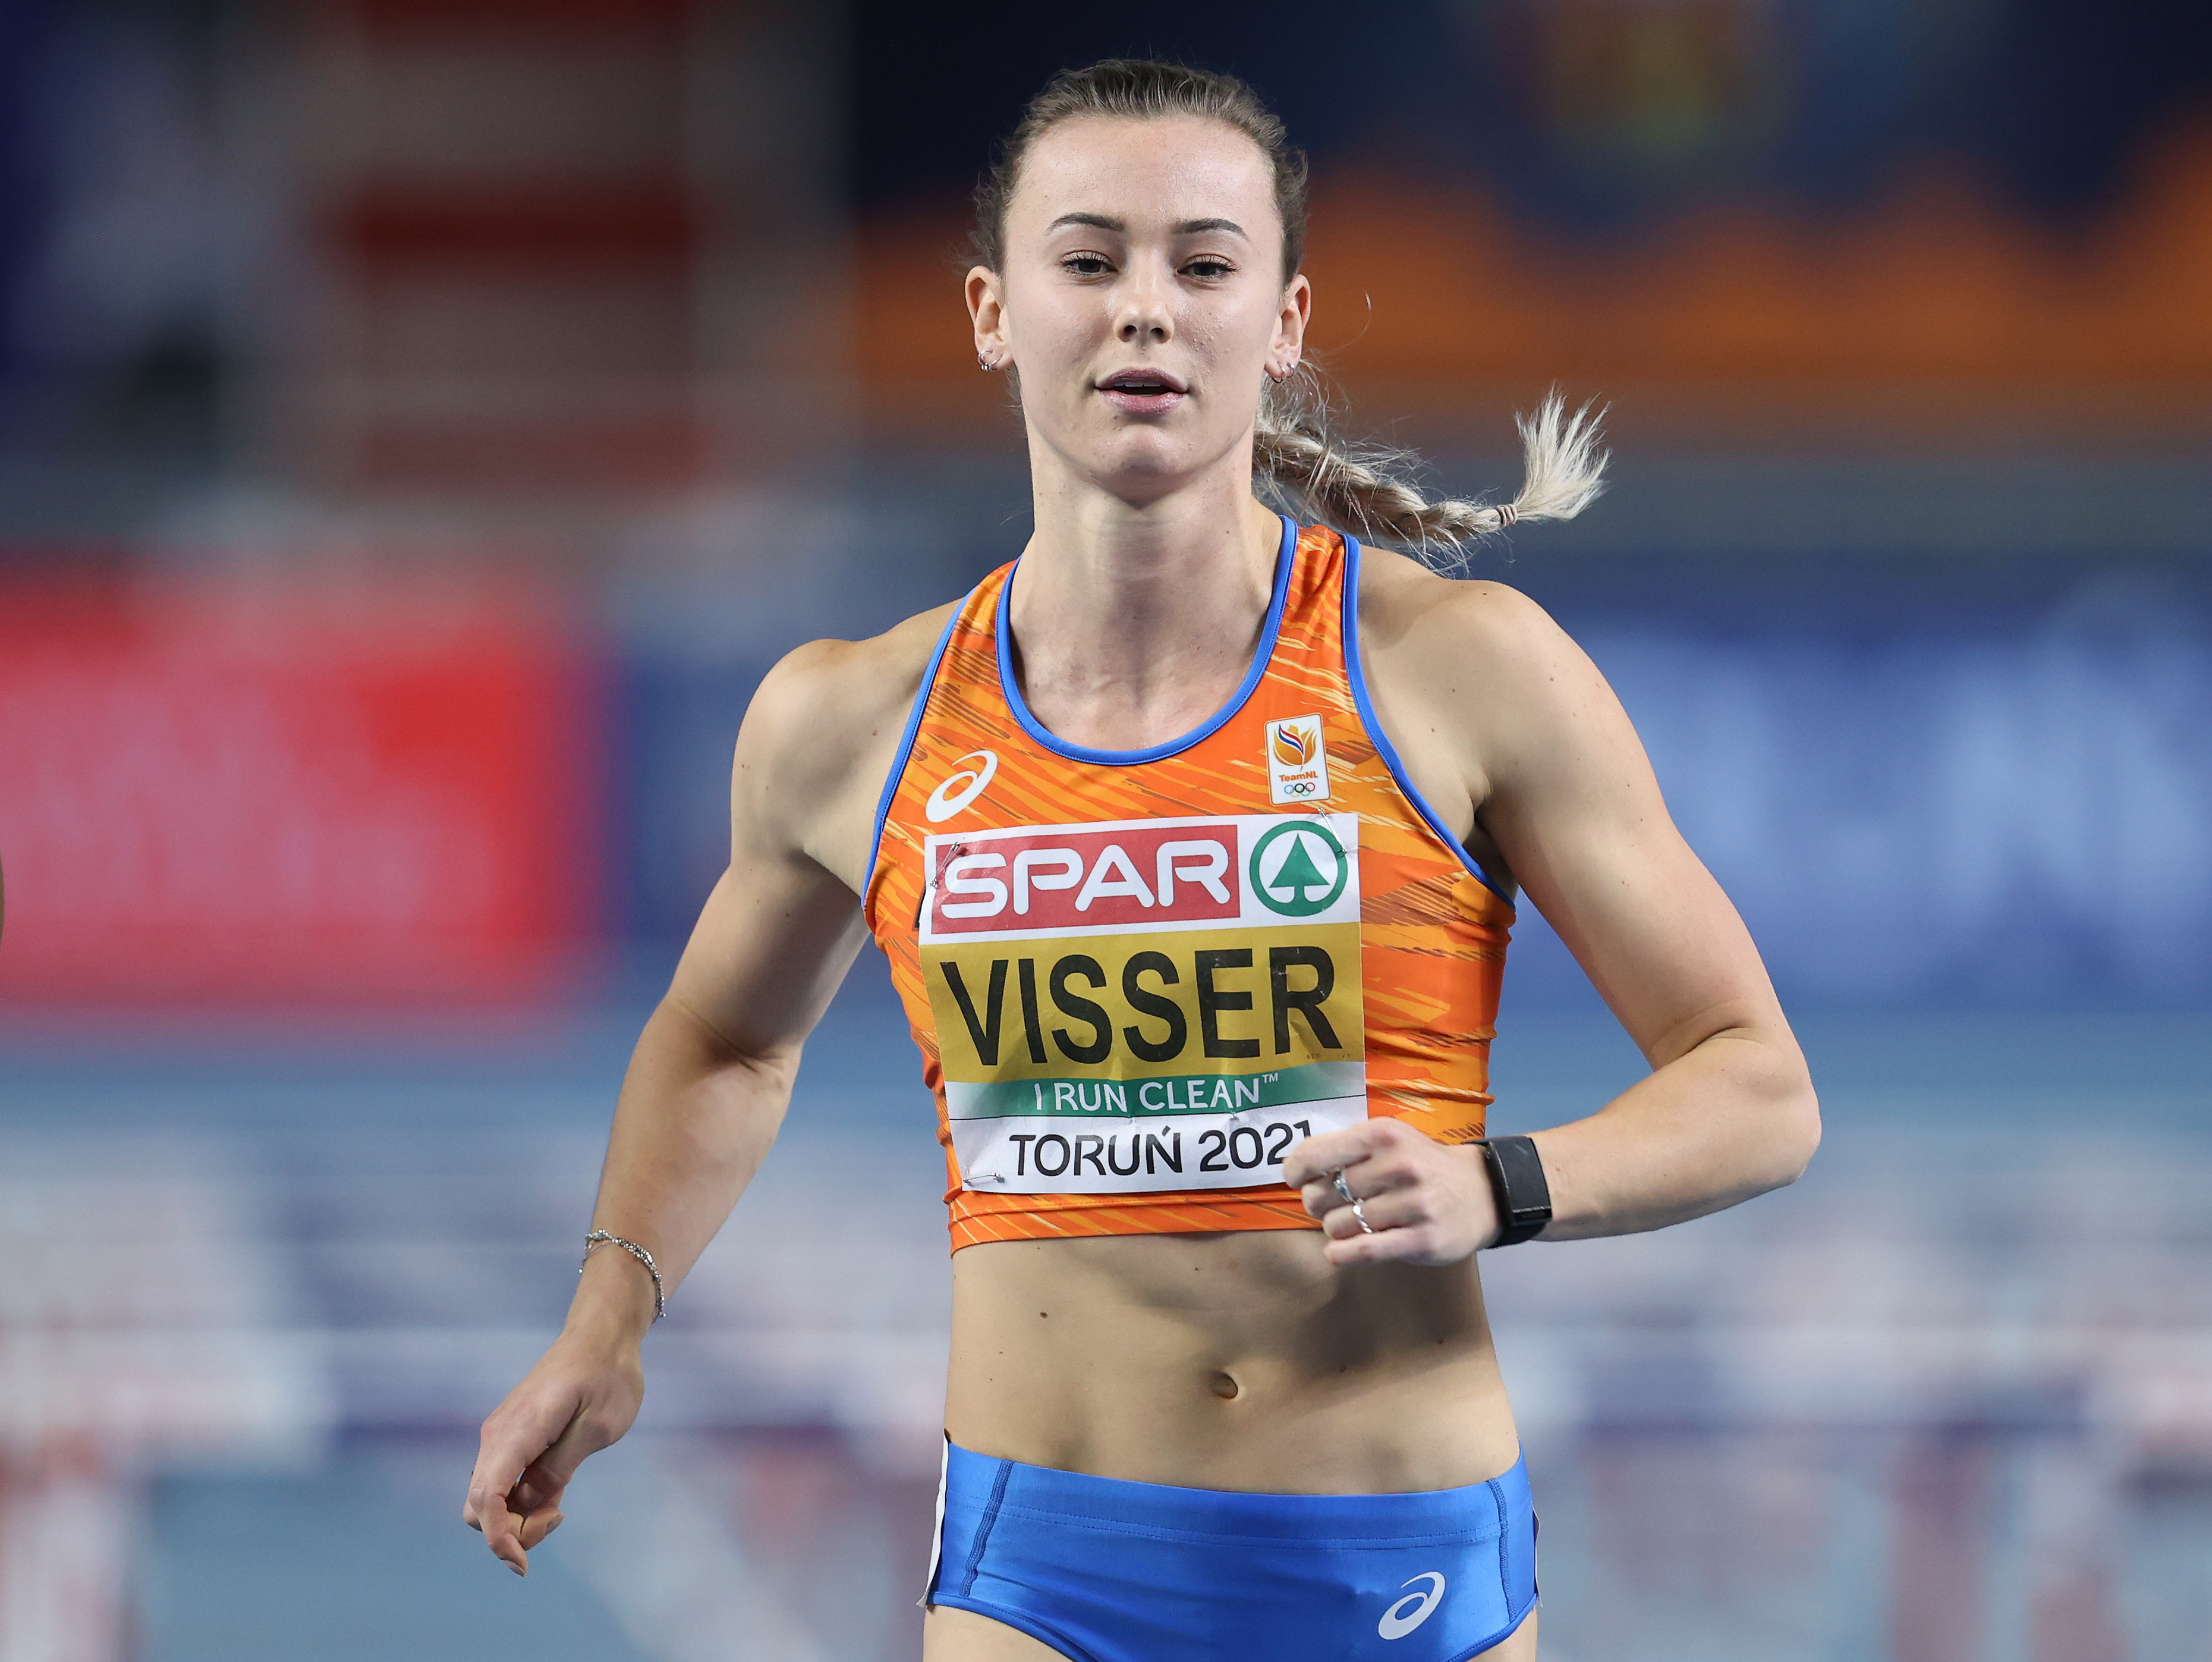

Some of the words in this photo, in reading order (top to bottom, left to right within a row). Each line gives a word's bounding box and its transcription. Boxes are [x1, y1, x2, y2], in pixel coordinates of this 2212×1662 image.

[1279, 771, 1318, 782] TeamNL
[941, 839, 1231, 919] SPAR
[940, 945, 1343, 1066] VISSER
[1034, 1083, 1043, 1111] I
[1054, 1082, 1128, 1113] RUN
[1009, 1125, 1183, 1177] TORUŃ
